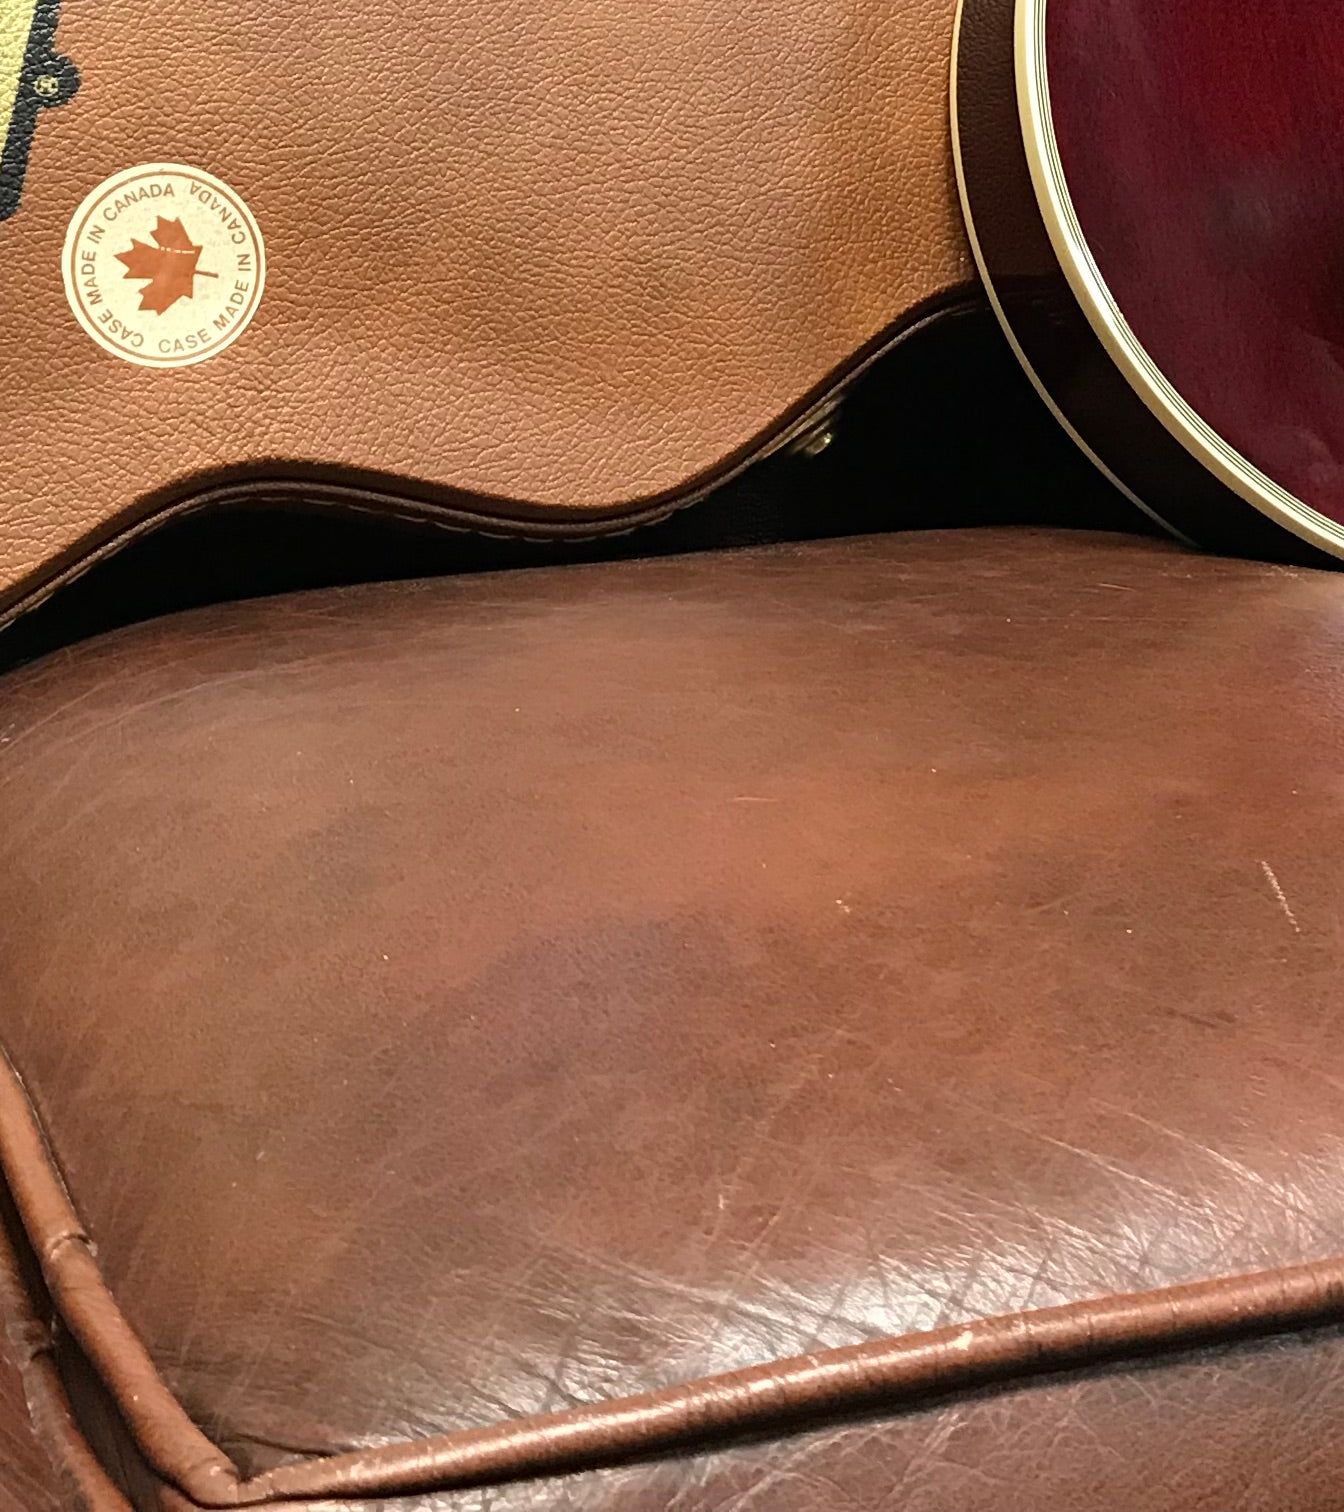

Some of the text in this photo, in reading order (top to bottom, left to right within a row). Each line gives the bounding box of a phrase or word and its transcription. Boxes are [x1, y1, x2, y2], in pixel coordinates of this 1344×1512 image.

[81, 183, 176, 348] CASE MADE IN CANADA
[158, 181, 252, 353] CASE MADE IN CANADA
